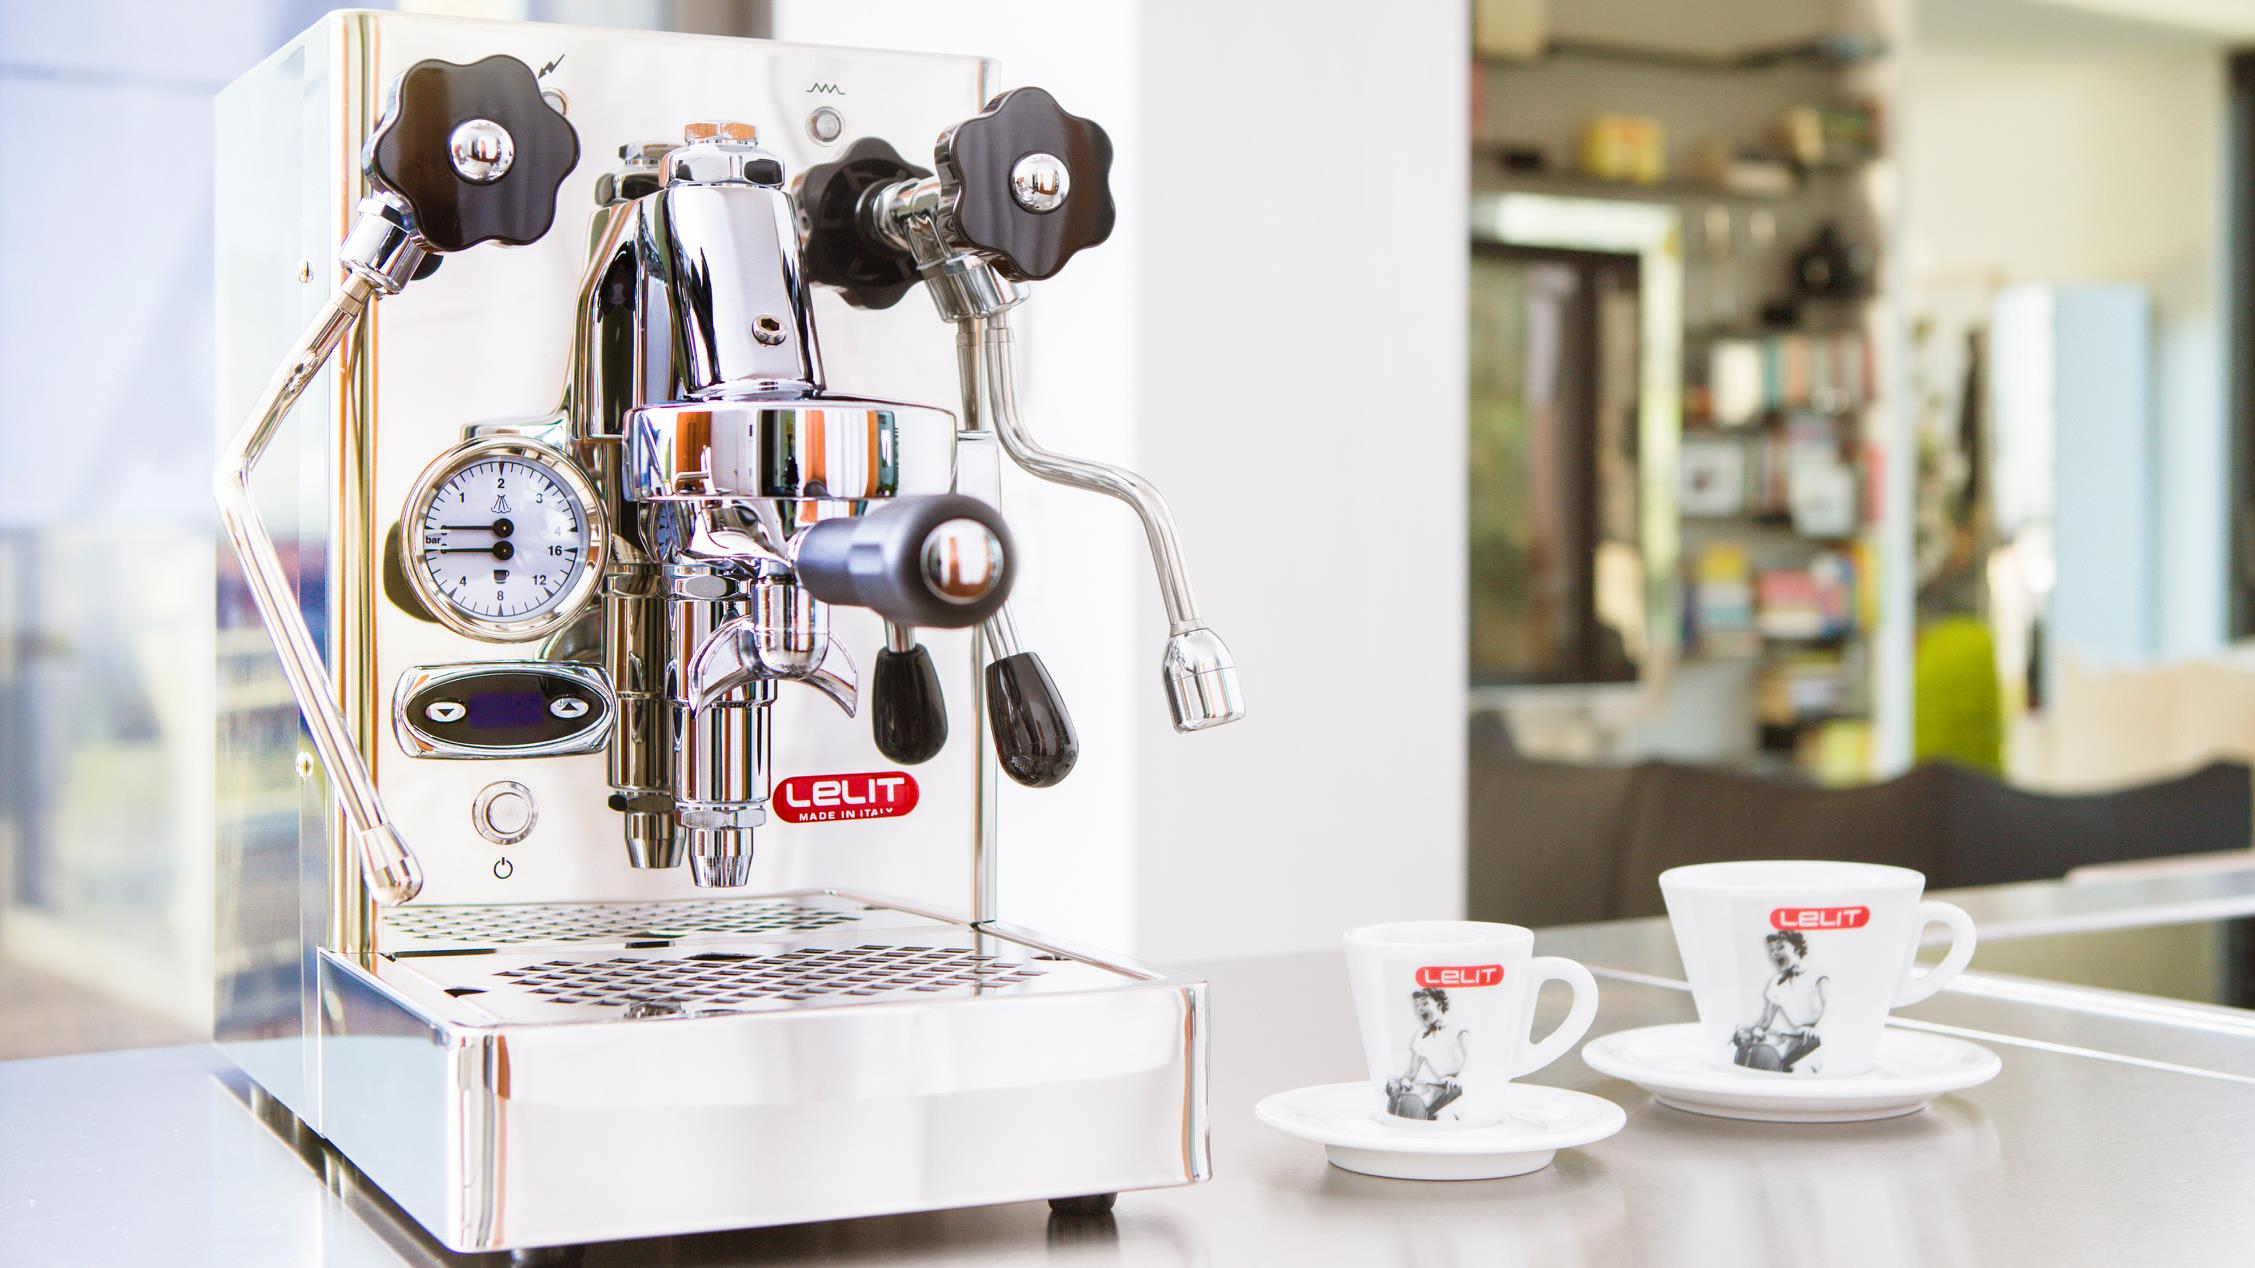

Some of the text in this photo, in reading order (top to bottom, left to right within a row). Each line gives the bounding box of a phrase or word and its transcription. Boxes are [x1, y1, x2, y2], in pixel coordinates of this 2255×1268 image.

[497, 478, 505, 489] 2
[458, 492, 465, 503] 1
[535, 493, 543, 503] 3
[554, 526, 561, 536] 4
[425, 535, 441, 544] bar
[548, 545, 562, 556] 16
[459, 576, 467, 586] 4
[532, 575, 547, 586] 12
[496, 591, 504, 601] 8
[799, 811, 836, 822] MADE
[841, 810, 855, 819] IN
